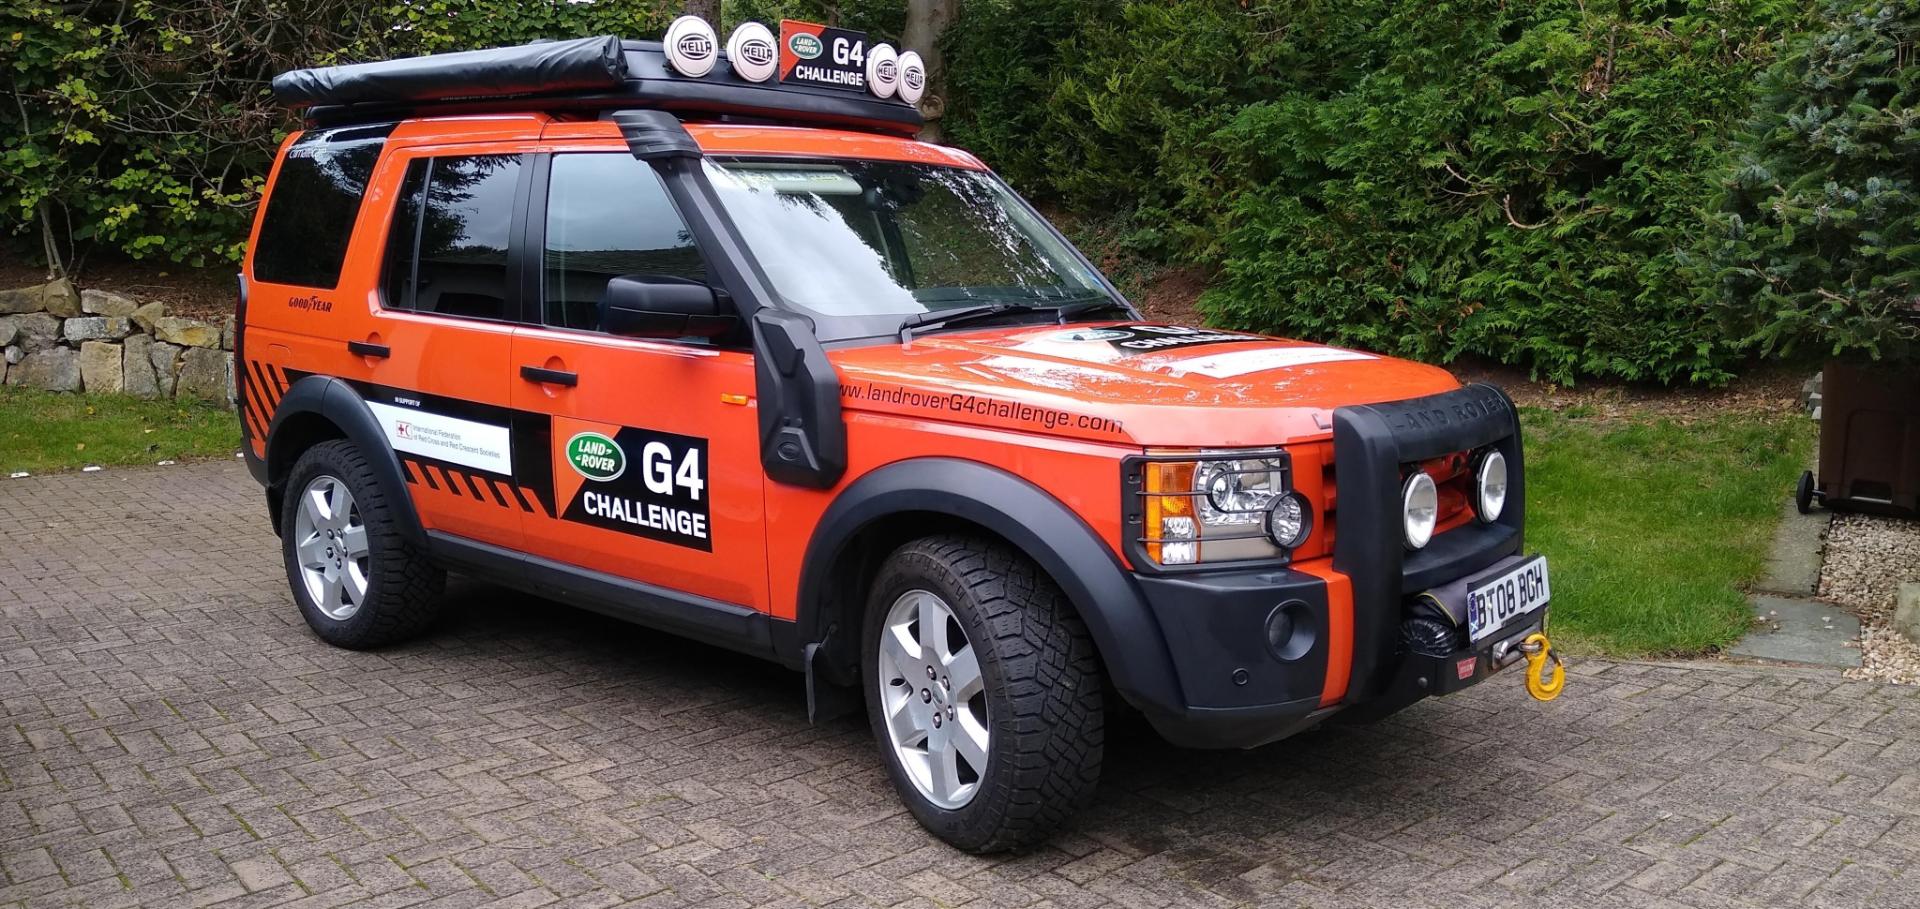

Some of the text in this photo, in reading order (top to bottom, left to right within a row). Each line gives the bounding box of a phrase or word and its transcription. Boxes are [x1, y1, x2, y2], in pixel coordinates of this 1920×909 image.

[680, 40, 712, 53] HELLA
[796, 37, 812, 46] LAND
[797, 45, 817, 54] ROVER
[743, 46, 773, 60] HELLA
[833, 36, 864, 67] G4
[795, 65, 863, 86] CHALLENGE
[288, 295, 332, 312] GOODYEAR
[578, 439, 606, 456] LAND
[581, 453, 616, 472] ROVER
[643, 441, 704, 501] G4
[583, 491, 707, 539] CHALLENGE
[1476, 579, 1516, 629] BT08
